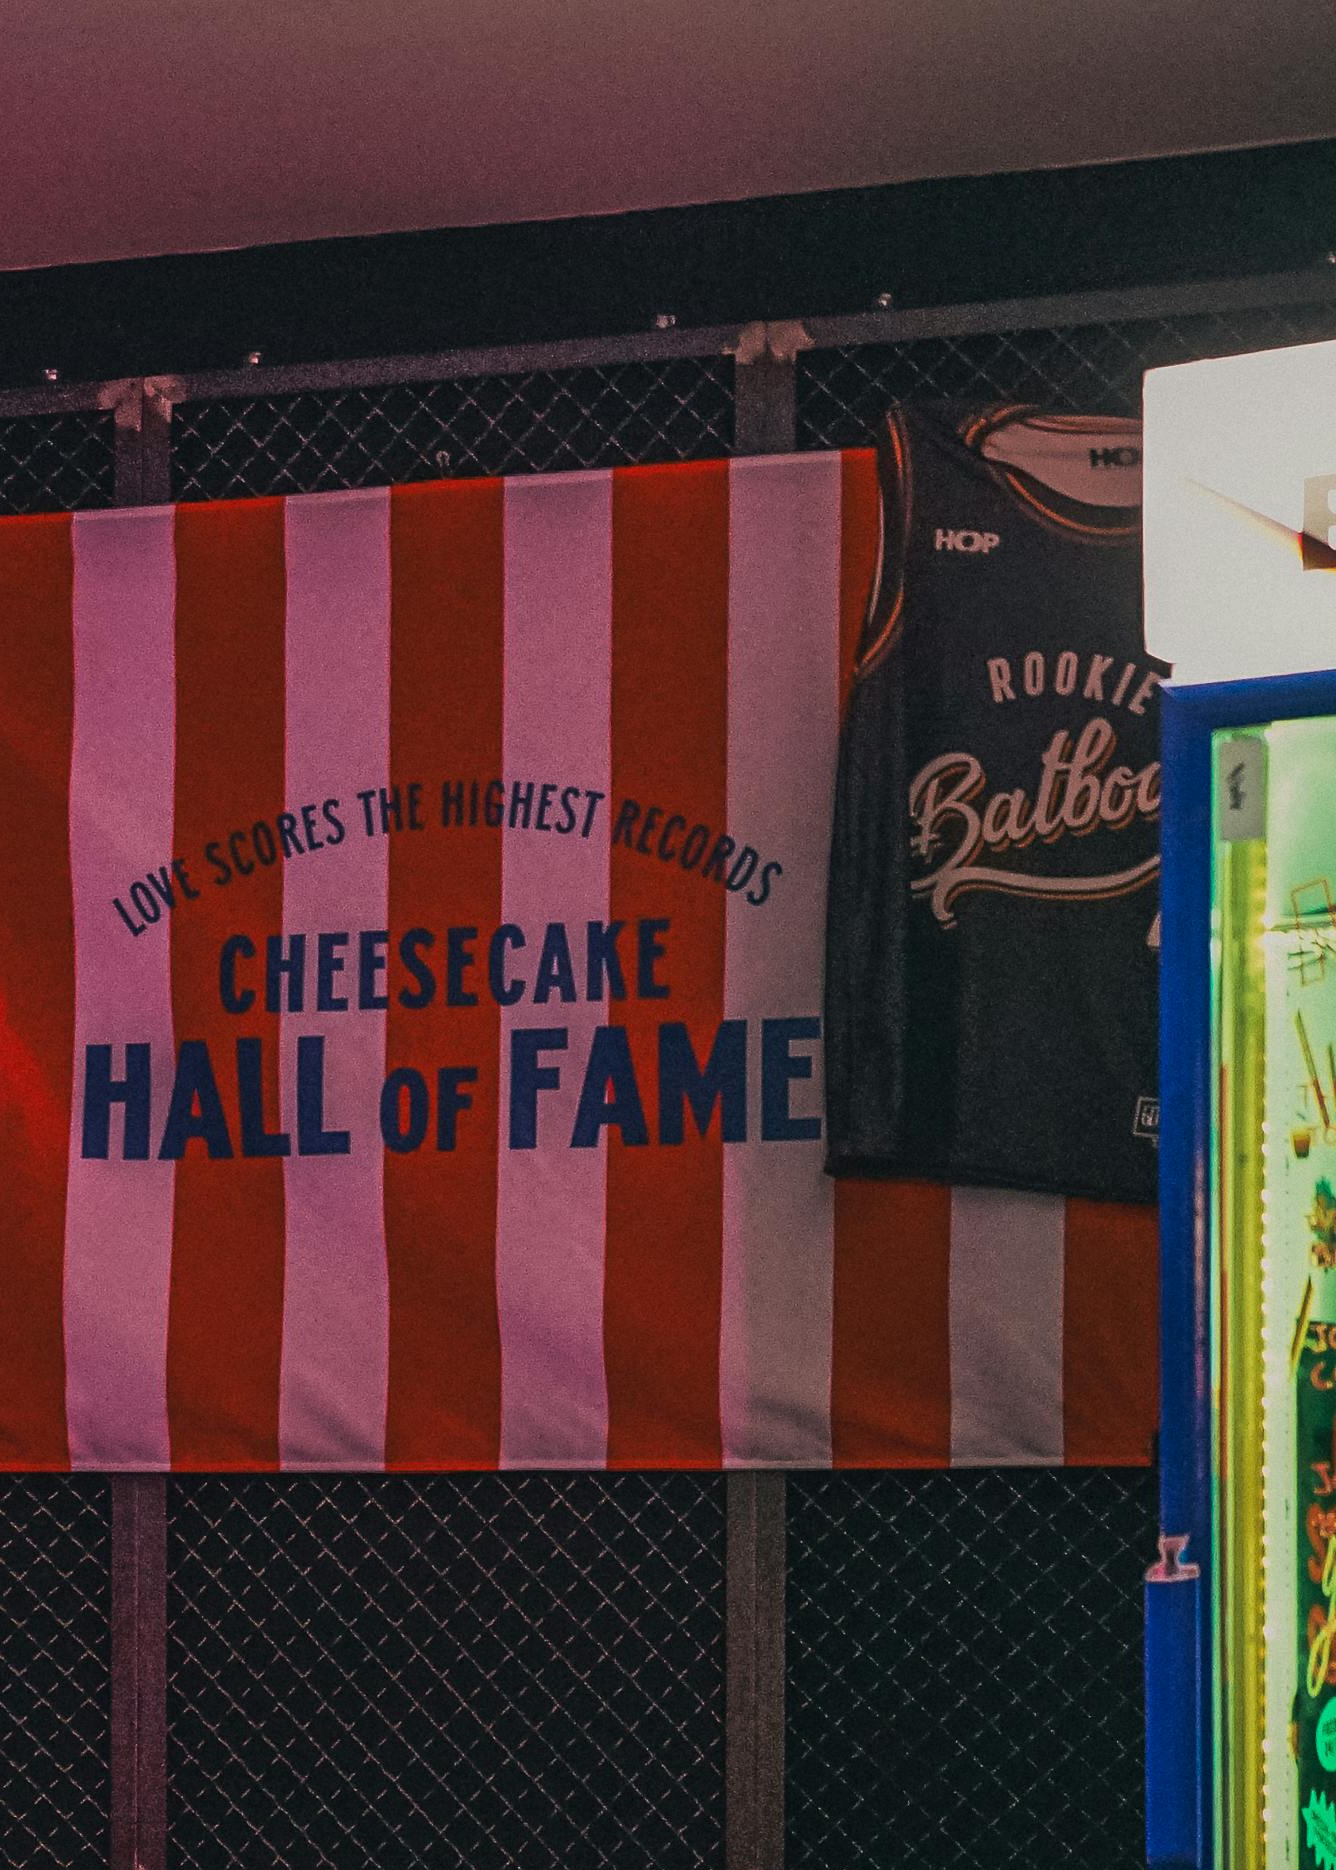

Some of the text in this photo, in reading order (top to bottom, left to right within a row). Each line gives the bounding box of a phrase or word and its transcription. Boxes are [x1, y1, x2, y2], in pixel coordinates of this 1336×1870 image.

[1090, 447, 1141, 467] HO
[935, 528, 1000, 554] HOP
[112, 779, 784, 938] LOVE SCORES THE HIGHEST RECORDS
[219, 917, 672, 1015] CHEESECAKE
[80, 1016, 822, 1162] HALL OF FAME
